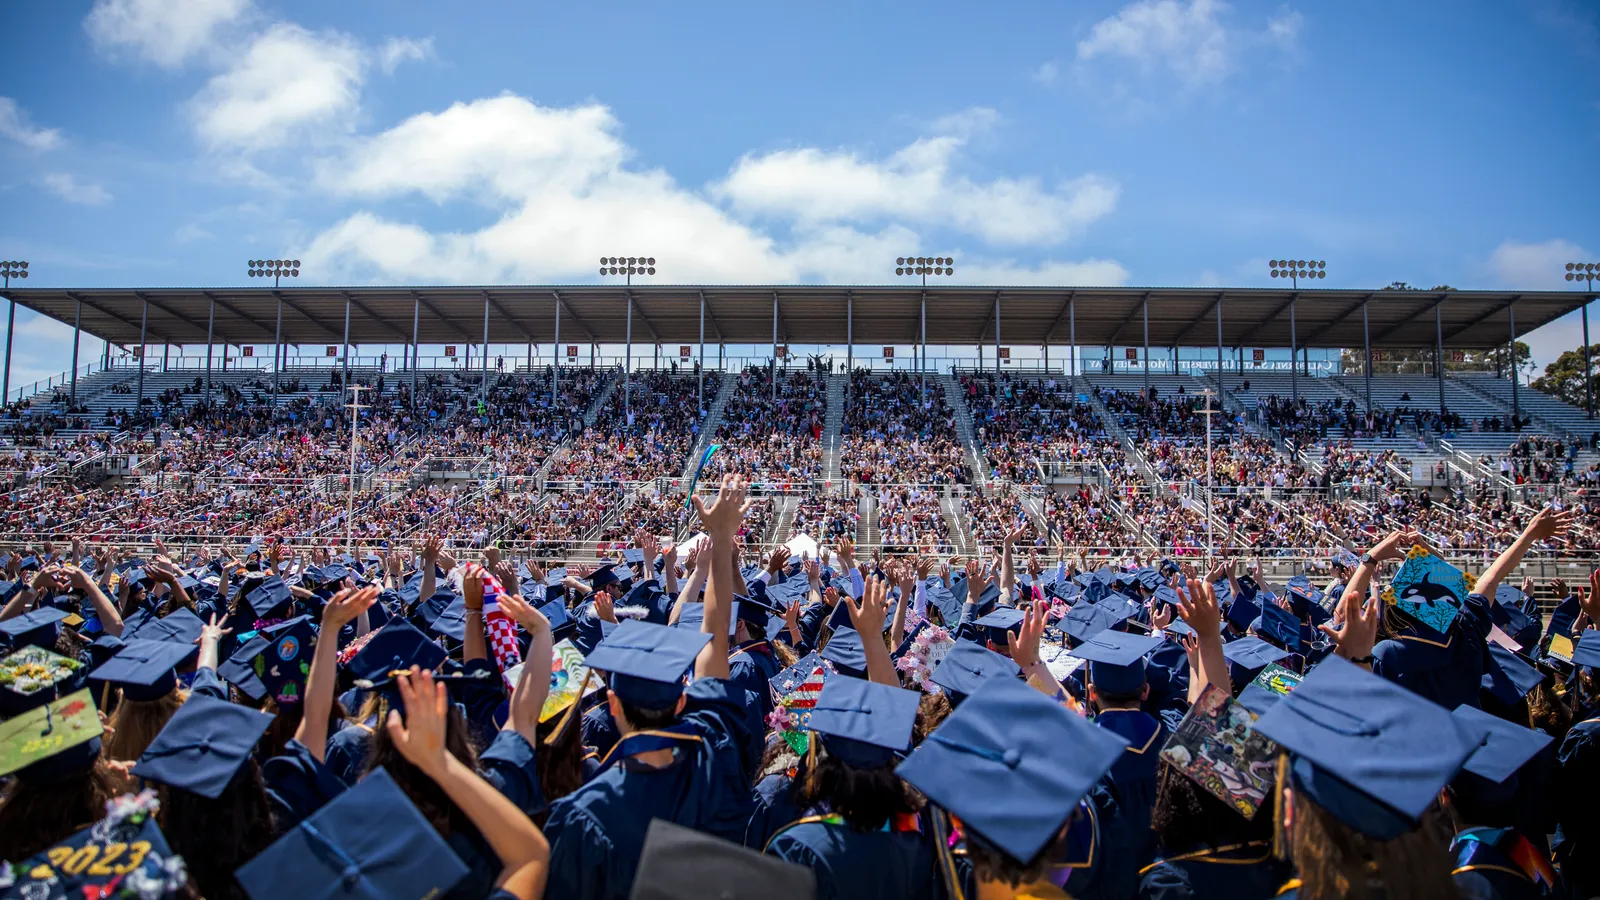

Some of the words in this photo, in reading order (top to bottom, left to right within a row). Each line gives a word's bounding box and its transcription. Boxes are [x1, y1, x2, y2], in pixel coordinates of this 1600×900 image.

[134, 348, 142, 356] 10
[245, 348, 251, 356] 11
[328, 348, 336, 356] 12
[447, 348, 455, 356] 13
[569, 348, 576, 356] 14
[682, 348, 690, 356] 15
[776, 348, 784, 356] 16
[885, 349, 893, 357] 17
[1001, 350, 1009, 358] 18
[1254, 352, 1263, 360] 20
[31, 840, 152, 879] 2023
